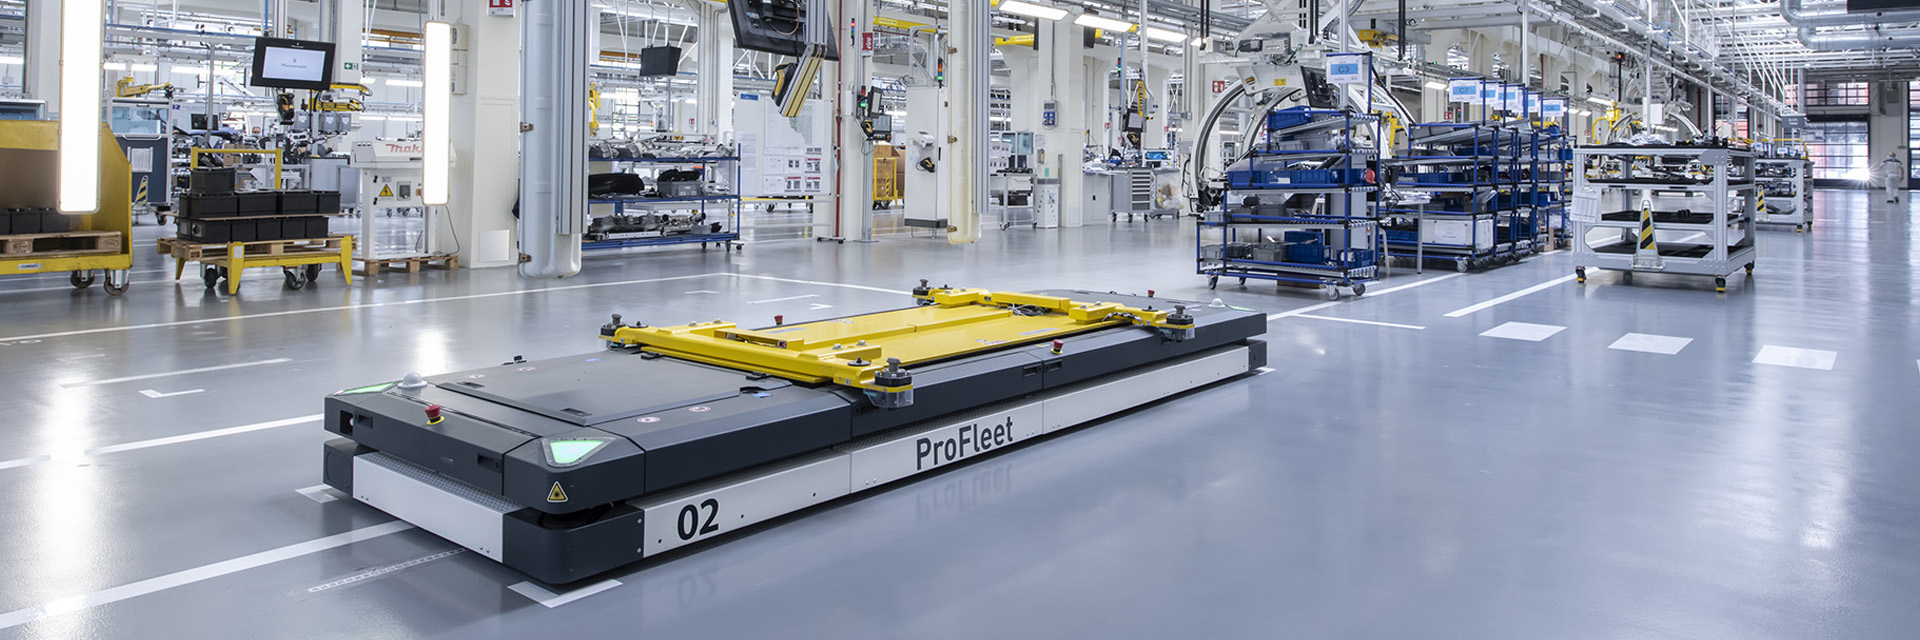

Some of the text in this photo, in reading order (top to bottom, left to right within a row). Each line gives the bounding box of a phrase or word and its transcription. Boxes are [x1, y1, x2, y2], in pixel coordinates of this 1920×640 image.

[1337, 65, 1350, 74] C3
[1459, 86, 1469, 94] C7
[386, 143, 422, 153] Mak
[916, 416, 1013, 470] ProFleet
[677, 498, 719, 541] 02
